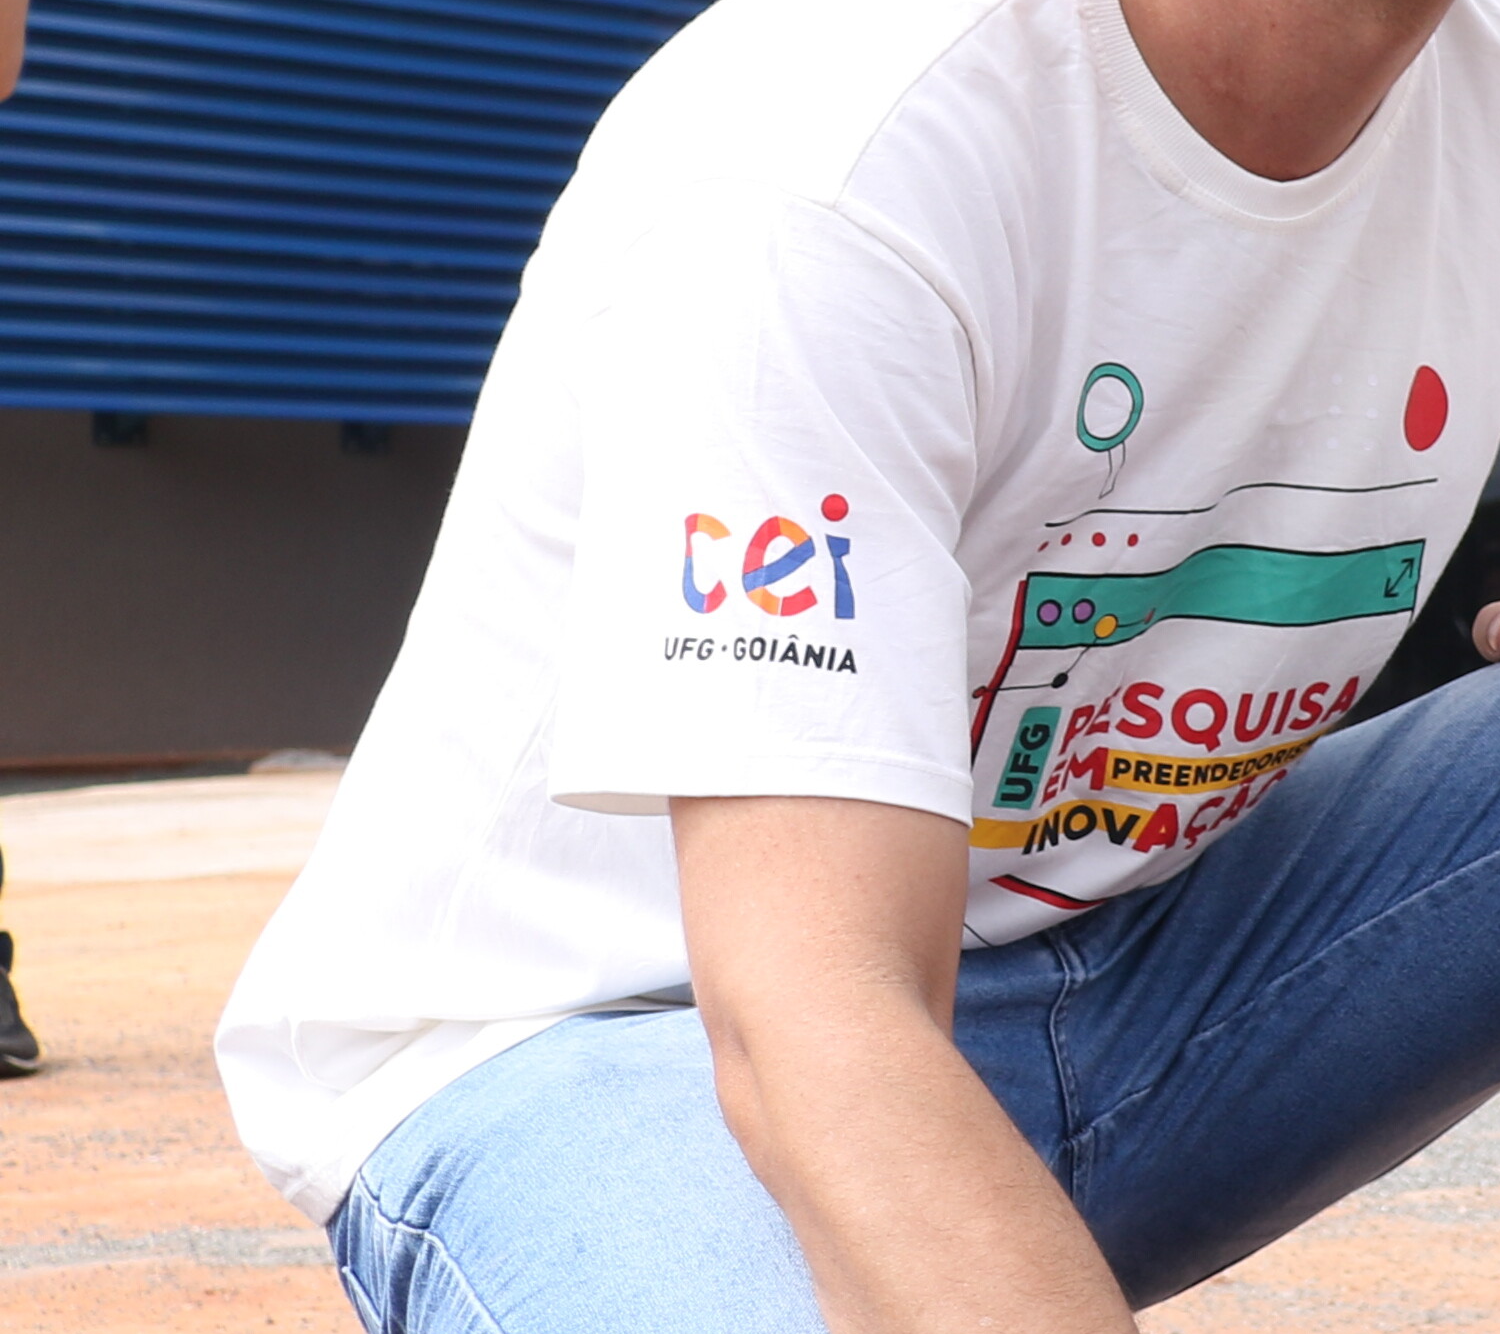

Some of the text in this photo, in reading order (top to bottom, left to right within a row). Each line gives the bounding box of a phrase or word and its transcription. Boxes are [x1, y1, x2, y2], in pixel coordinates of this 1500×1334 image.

[682, 493, 855, 619] cei
[733, 634, 858, 674] GOIÂNIA
[1058, 675, 1360, 756] PESQUISA
[1000, 723, 1051, 803] UFG
